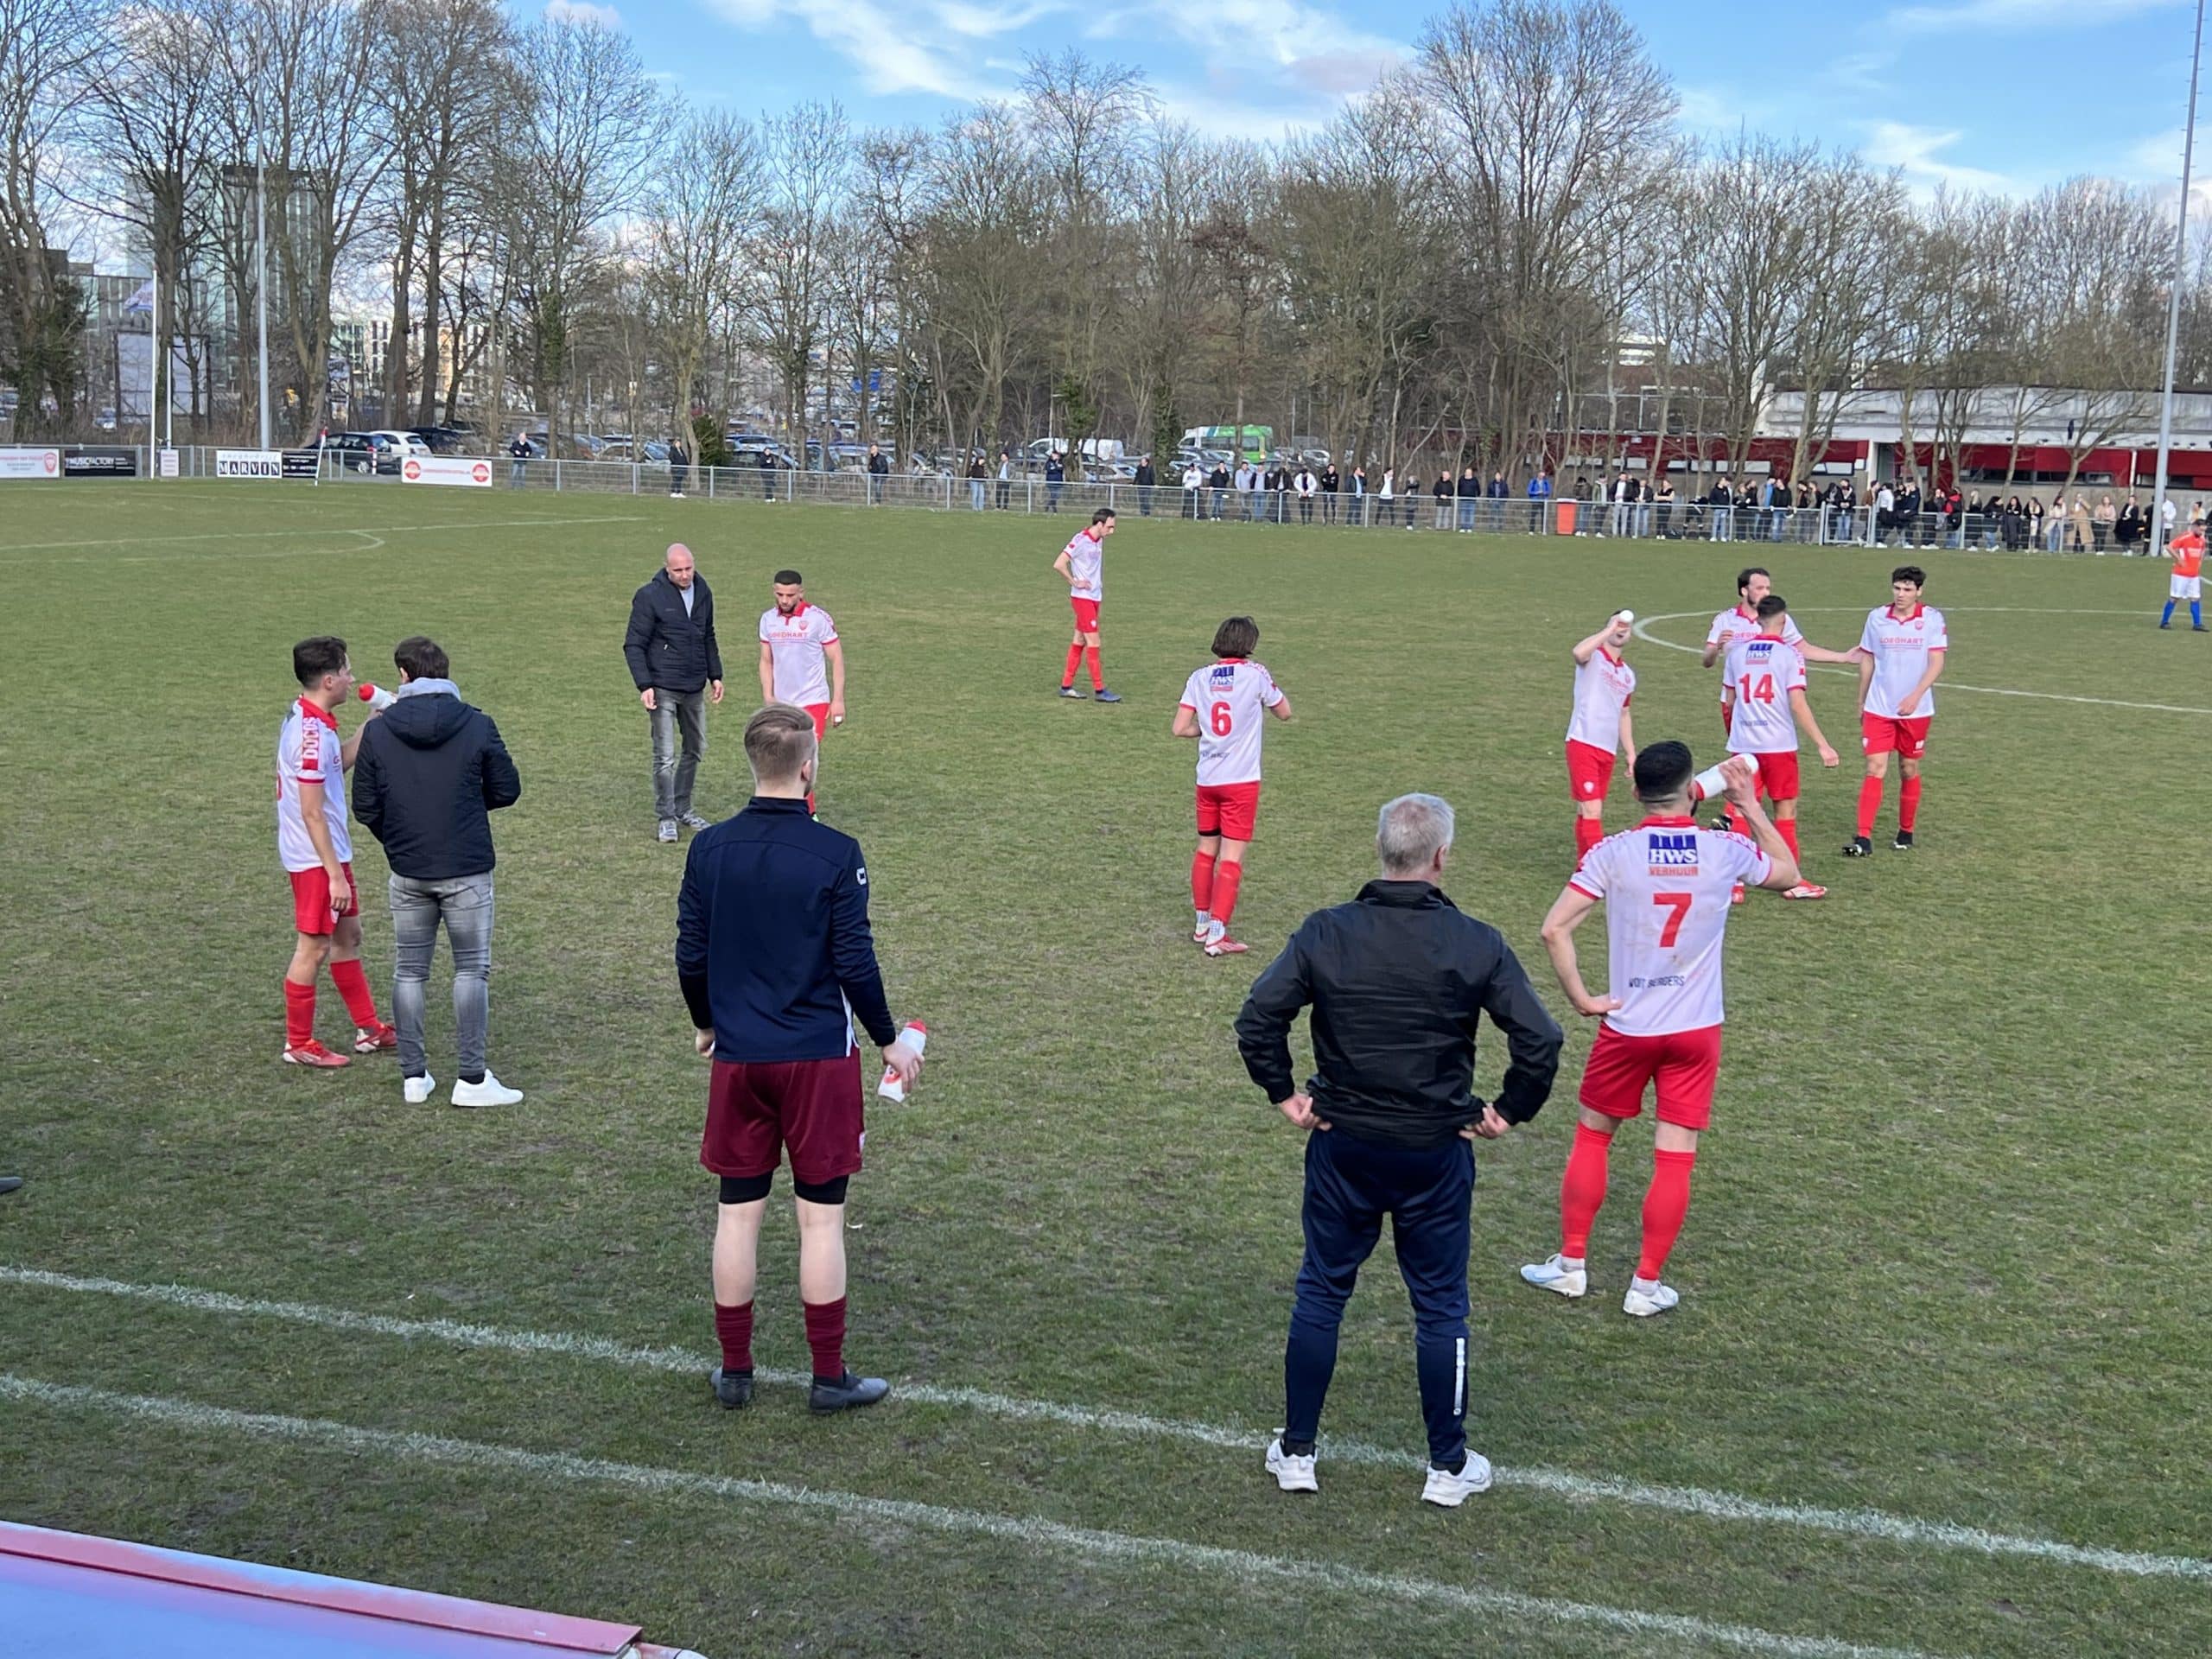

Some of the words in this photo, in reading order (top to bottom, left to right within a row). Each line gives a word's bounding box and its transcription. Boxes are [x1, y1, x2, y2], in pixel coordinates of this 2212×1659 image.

[219, 461, 279, 475] MARVIN
[1739, 673, 1775, 704] 14
[1211, 701, 1232, 737] 6
[1649, 849, 1699, 863] HWS
[1649, 866, 1699, 876] VERHUUR
[1653, 893, 1693, 948] 7
